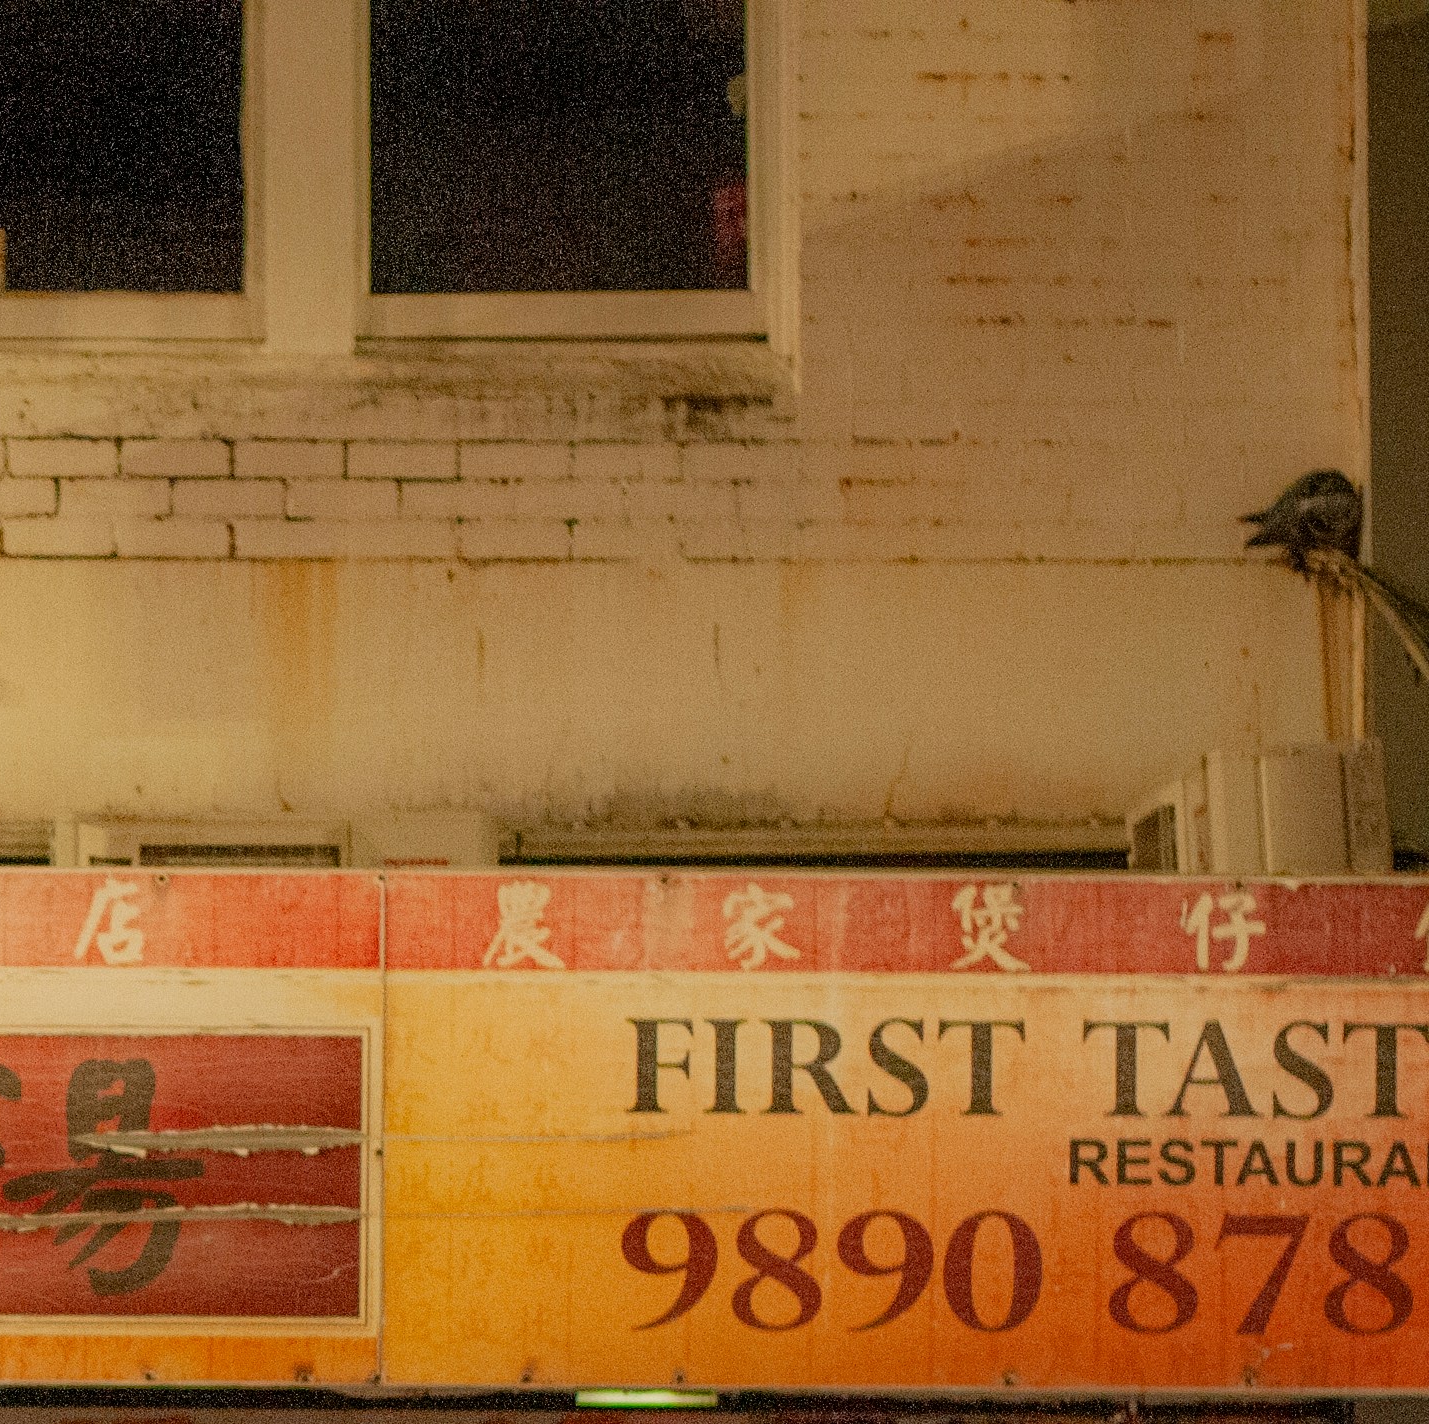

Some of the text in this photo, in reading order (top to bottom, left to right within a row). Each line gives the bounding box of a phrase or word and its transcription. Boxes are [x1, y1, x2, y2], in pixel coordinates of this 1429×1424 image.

[481, 880, 1429, 974] 農家煲仔
[625, 1017, 1429, 1122] FIRST TAST
[1069, 1137, 1429, 1190] RESTAURA
[619, 1207, 1416, 1337] 9890 878
